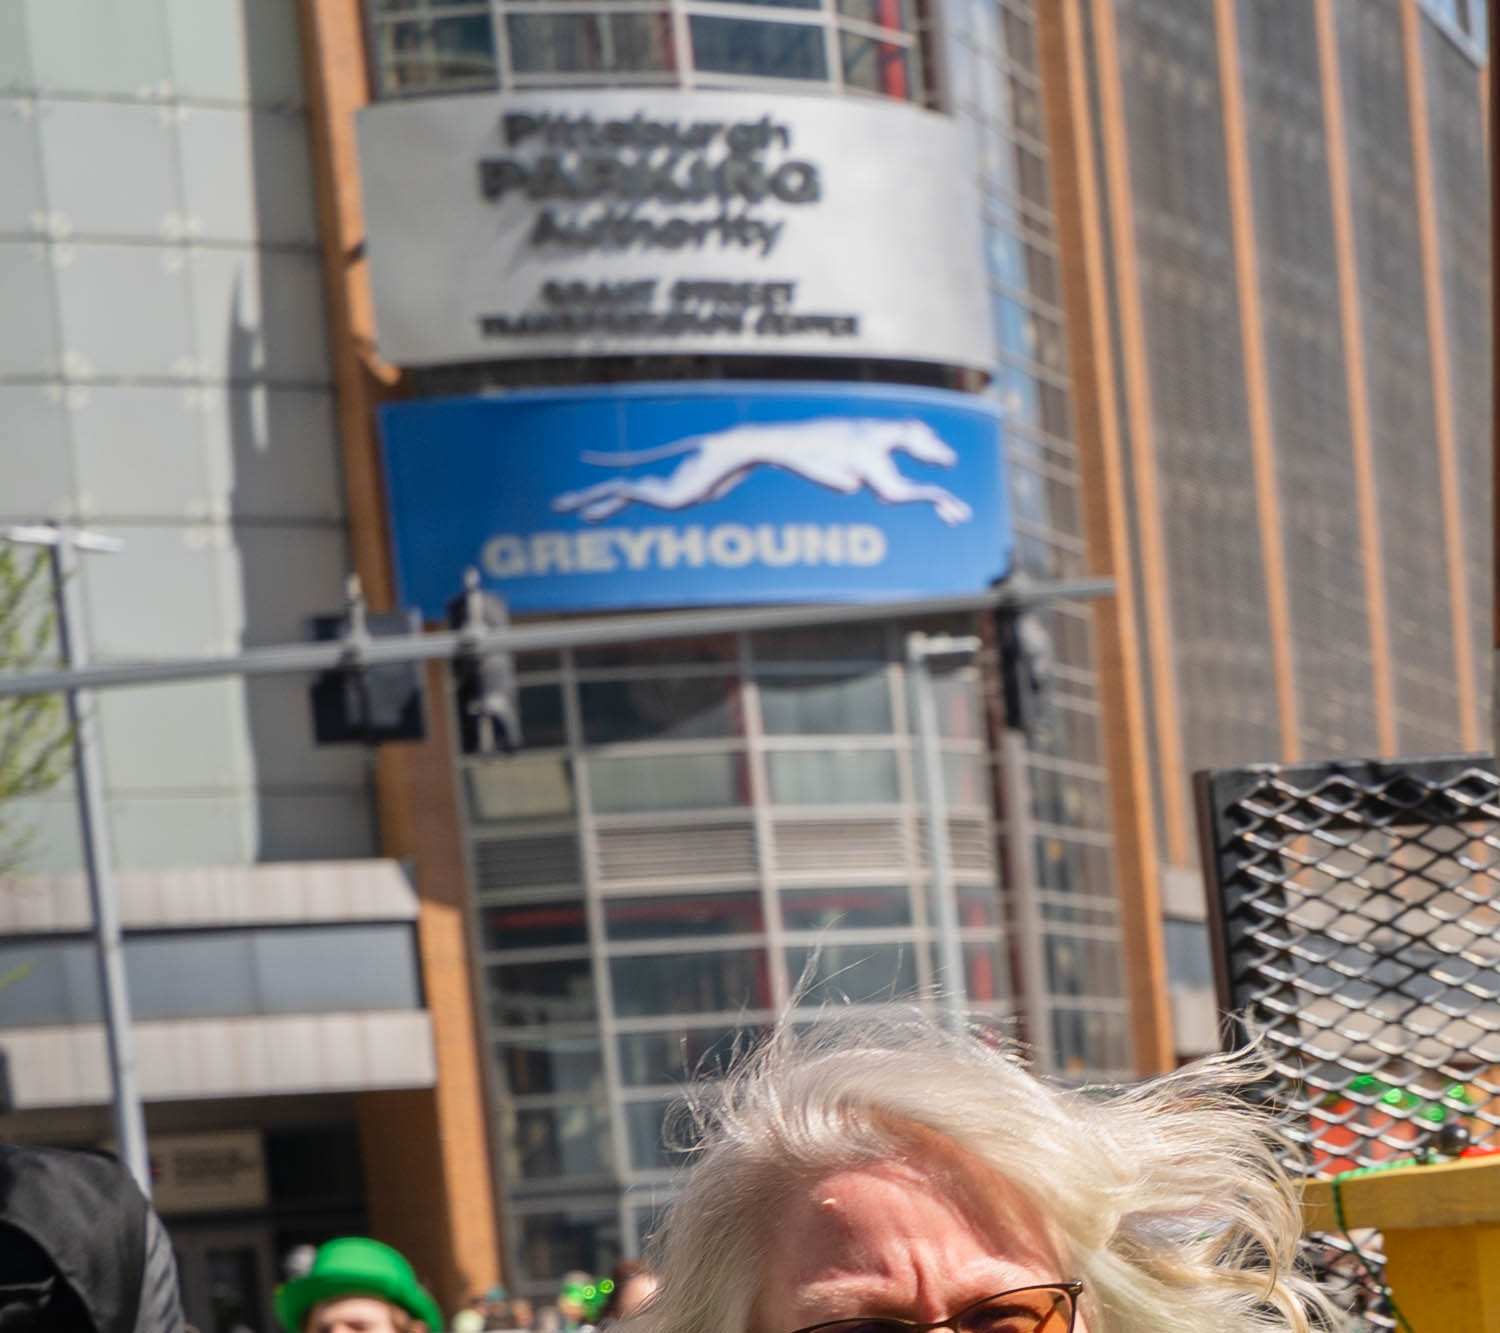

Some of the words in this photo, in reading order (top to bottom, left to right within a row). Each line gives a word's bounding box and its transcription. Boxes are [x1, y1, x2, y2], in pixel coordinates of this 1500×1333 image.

[504, 111, 790, 155] Pittsburgh
[479, 157, 822, 203] PARKING
[531, 204, 785, 258] Authority
[480, 523, 887, 578] GREYHOUND
